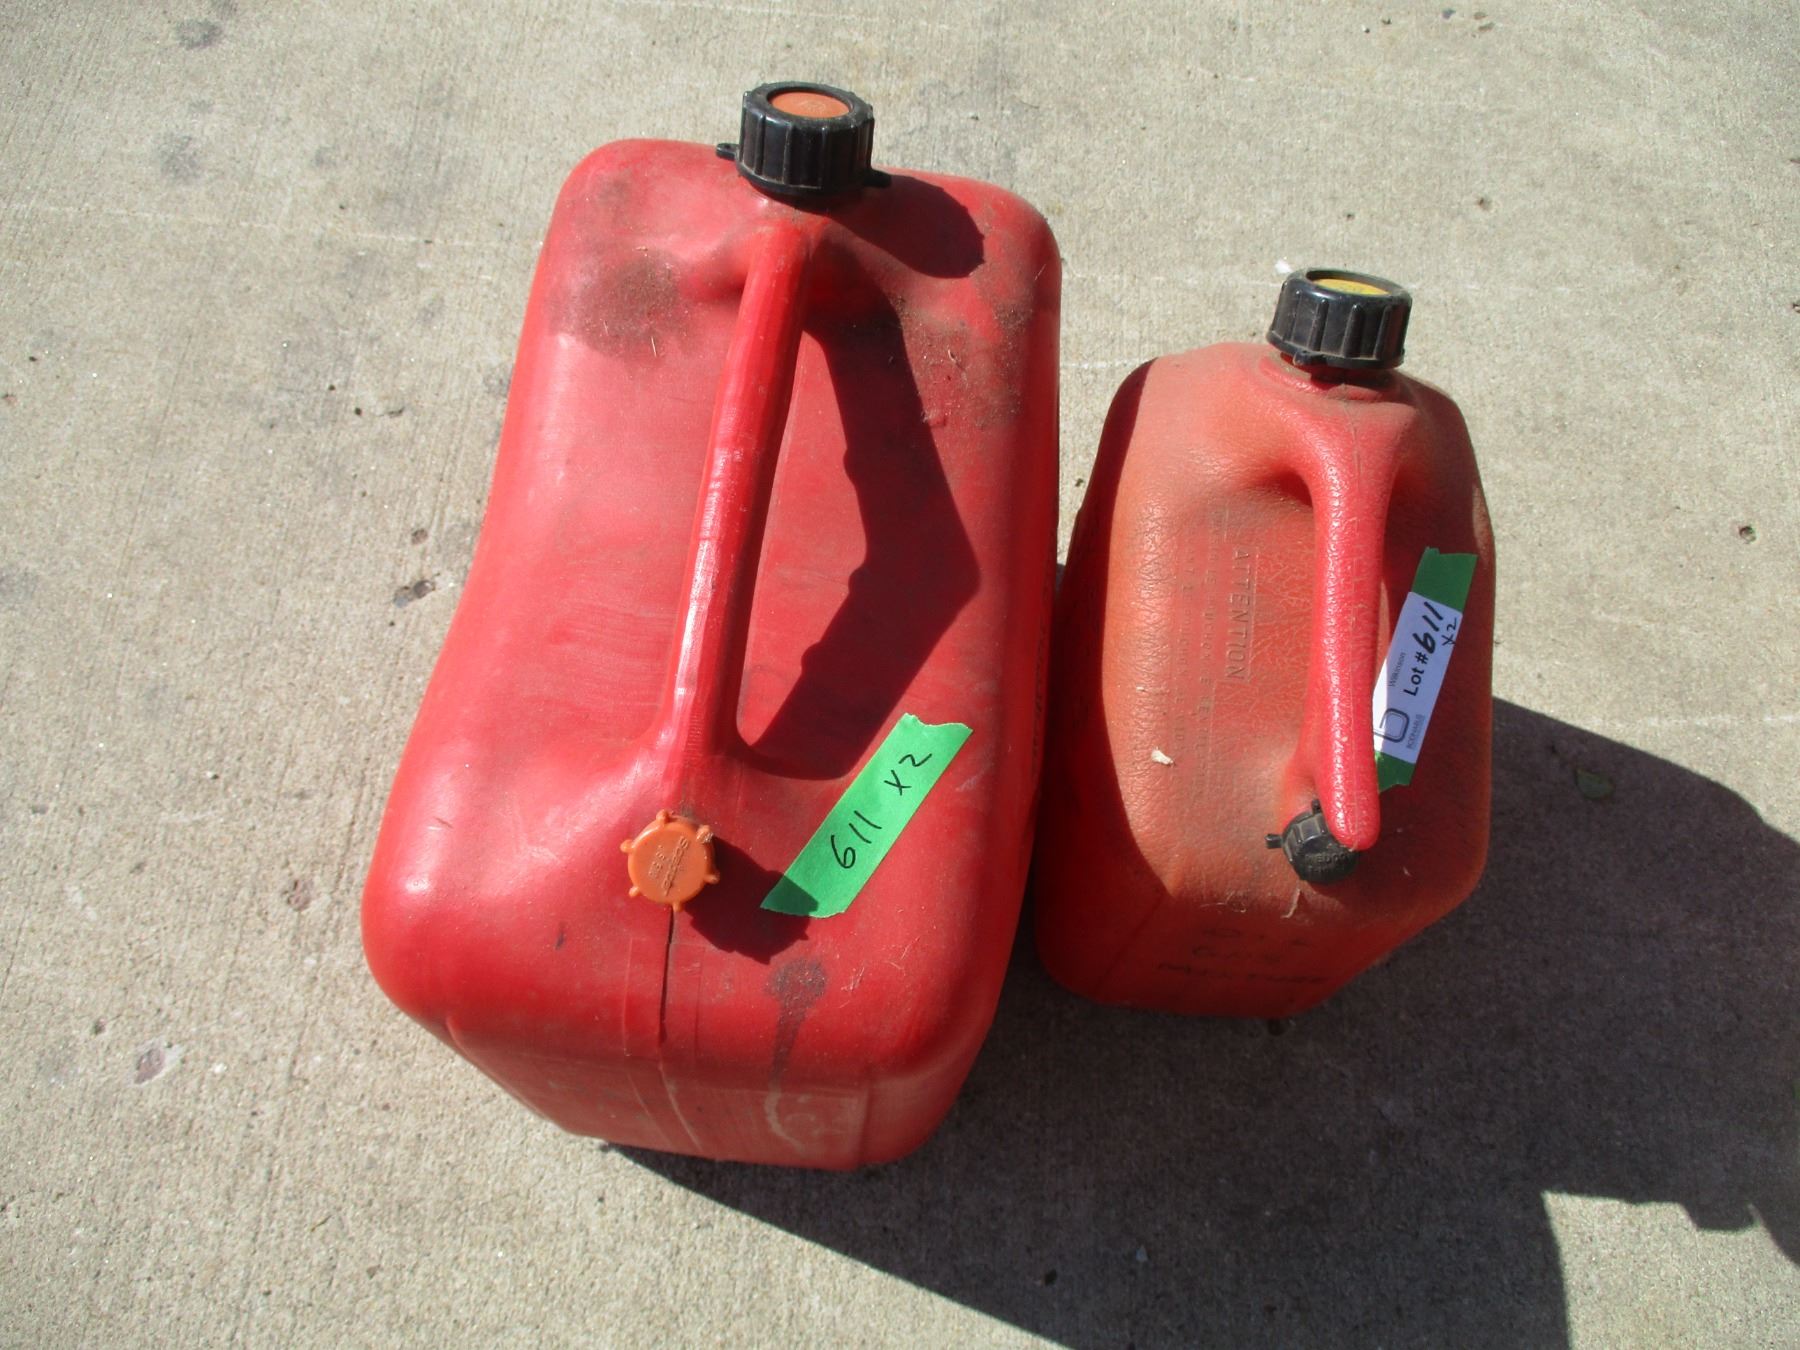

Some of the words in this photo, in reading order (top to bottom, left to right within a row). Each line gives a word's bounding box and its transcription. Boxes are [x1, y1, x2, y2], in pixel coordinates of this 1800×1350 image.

[1226, 546, 1250, 681] ATTENTION
[1403, 667, 1425, 696] Lot
[830, 810, 882, 869] 611
